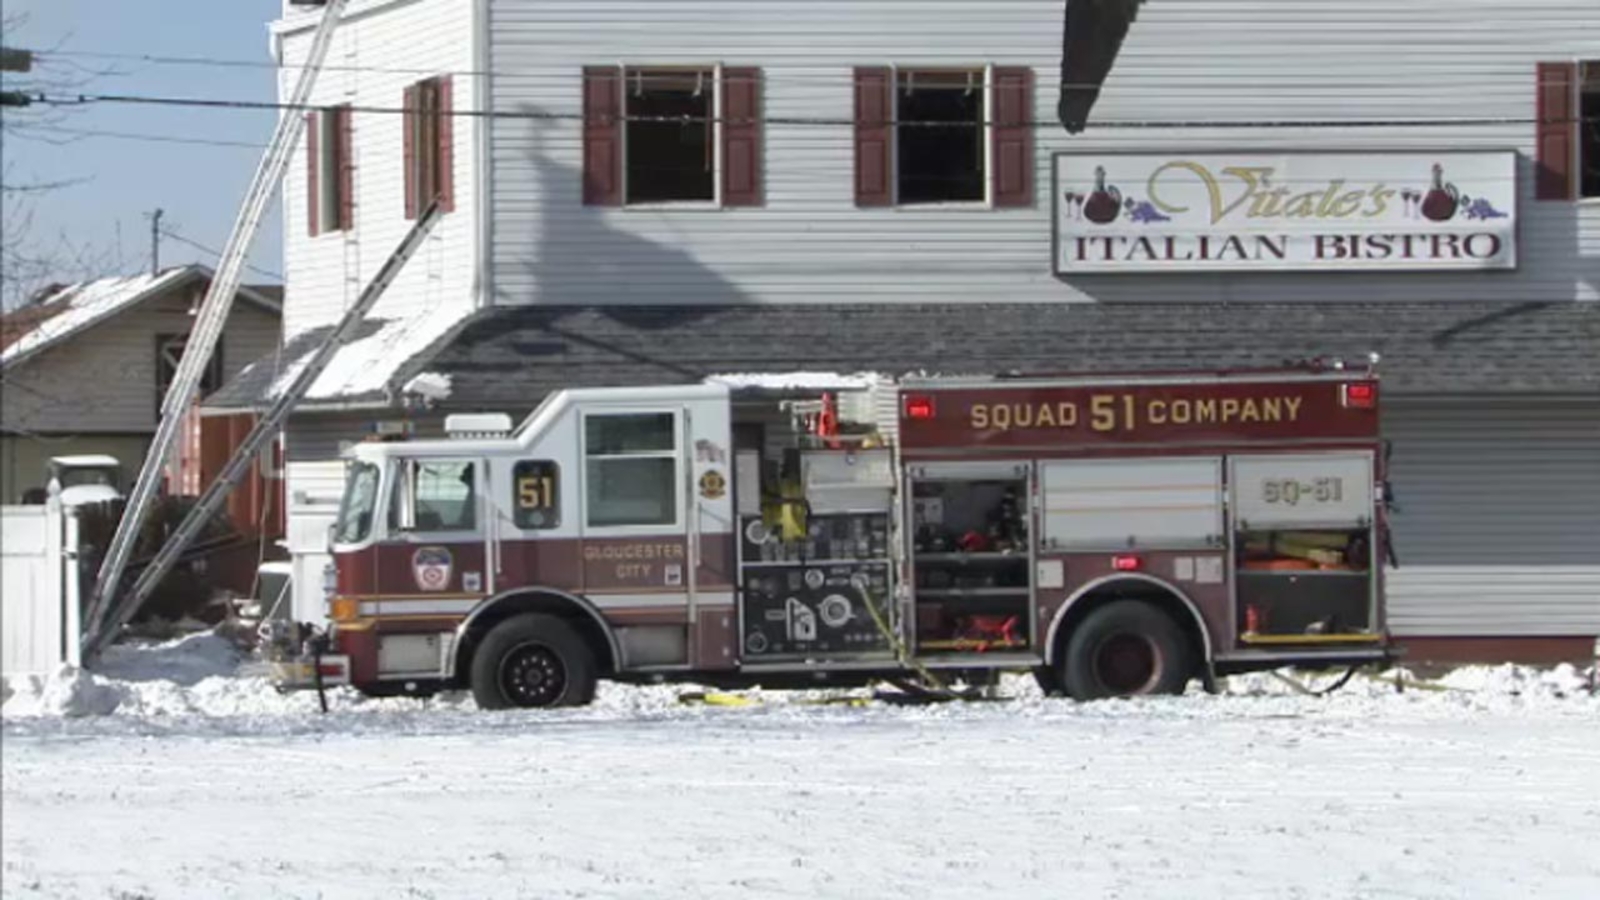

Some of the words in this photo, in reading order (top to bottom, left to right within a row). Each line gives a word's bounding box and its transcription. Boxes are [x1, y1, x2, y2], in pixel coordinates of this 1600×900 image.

[1147, 160, 1396, 225] Vitale's
[1074, 233, 1287, 262] ITALIAN
[1314, 232, 1501, 259] BISTRO
[971, 402, 1078, 428] SQUAD
[1090, 395, 1135, 431] 51
[1148, 397, 1302, 424] COMPANY
[518, 477, 552, 509] 51
[584, 544, 684, 559] GLOUCESTER
[616, 564, 653, 579] CITY
